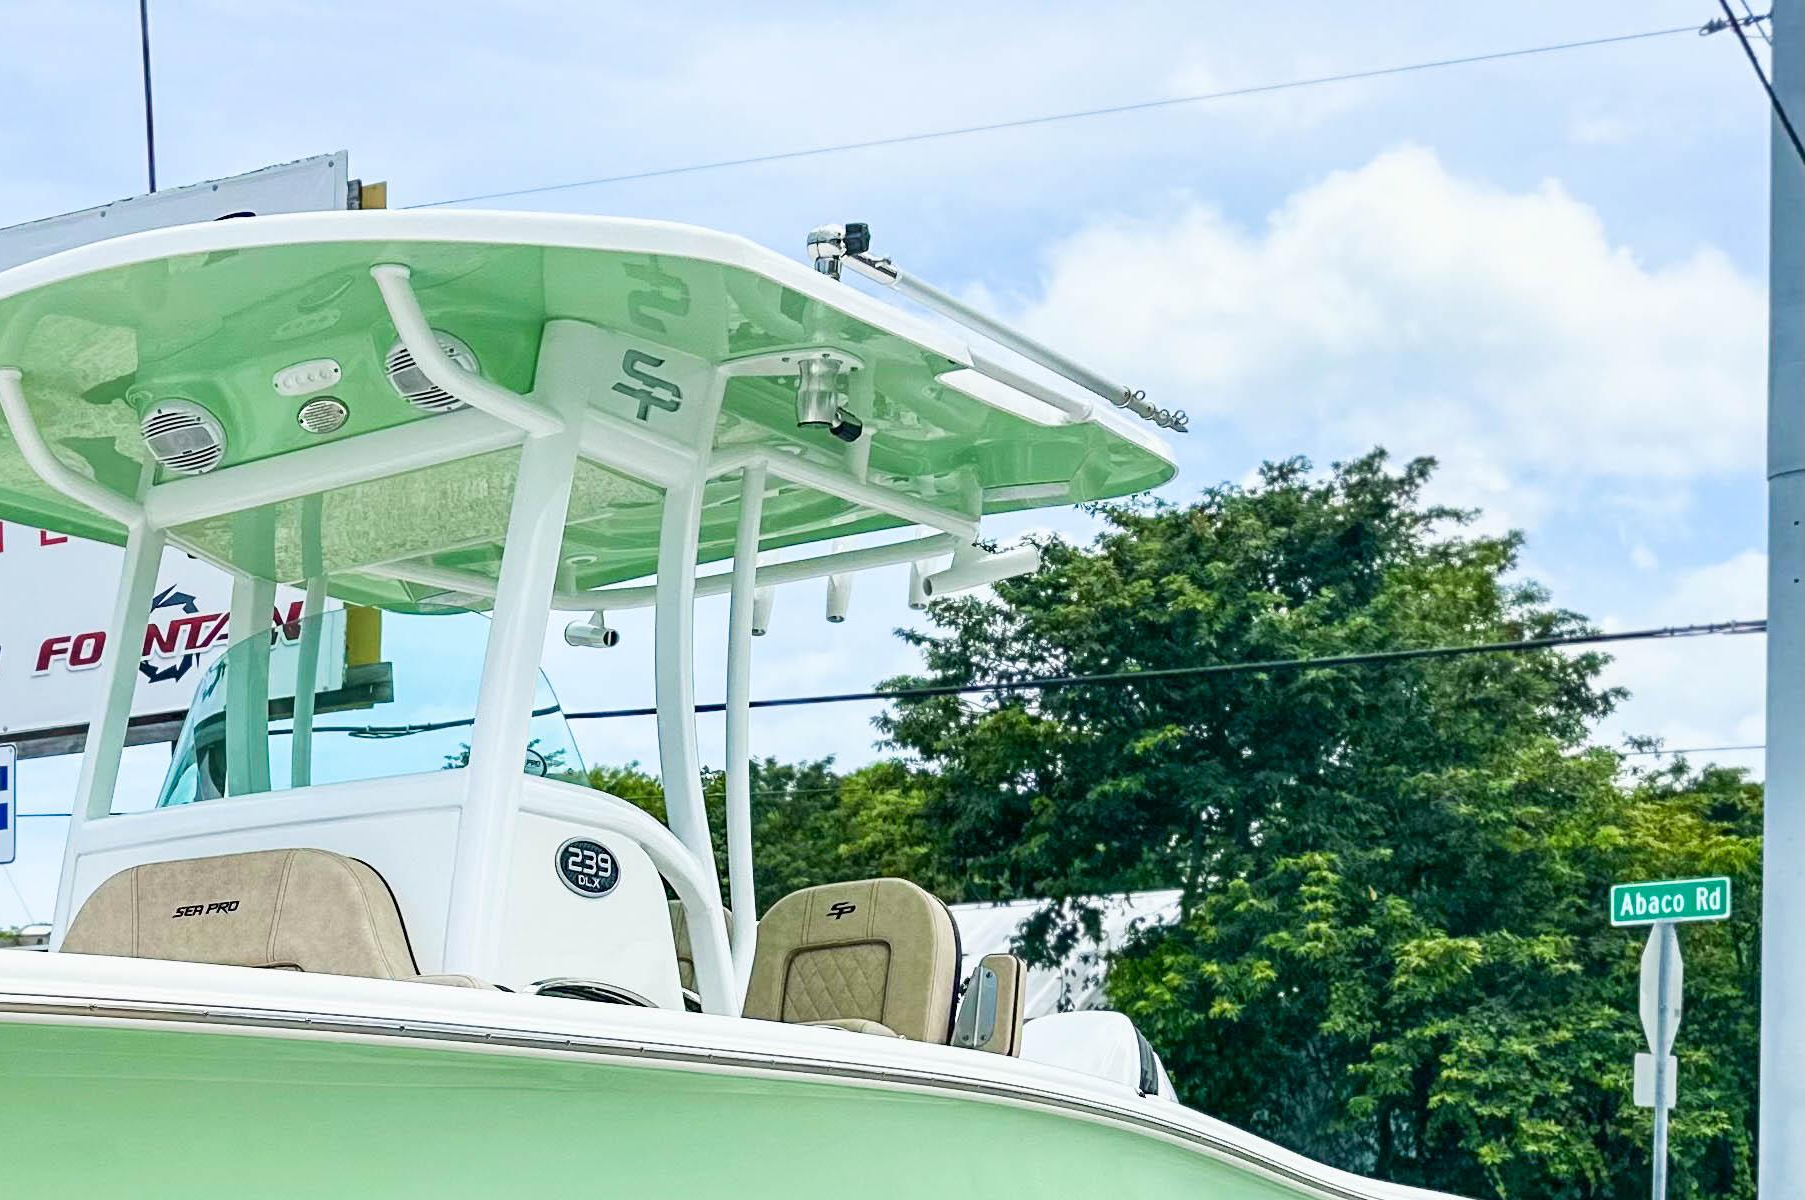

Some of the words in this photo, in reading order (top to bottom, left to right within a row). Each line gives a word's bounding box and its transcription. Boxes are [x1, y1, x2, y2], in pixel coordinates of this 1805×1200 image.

[35, 600, 304, 671] FONTAN
[568, 846, 612, 878] 239
[578, 874, 601, 889] DLX
[172, 904, 204, 918] SEA
[205, 900, 240, 914] PRO
[1619, 892, 1685, 917] Abaco
[1696, 886, 1721, 911] Rd
